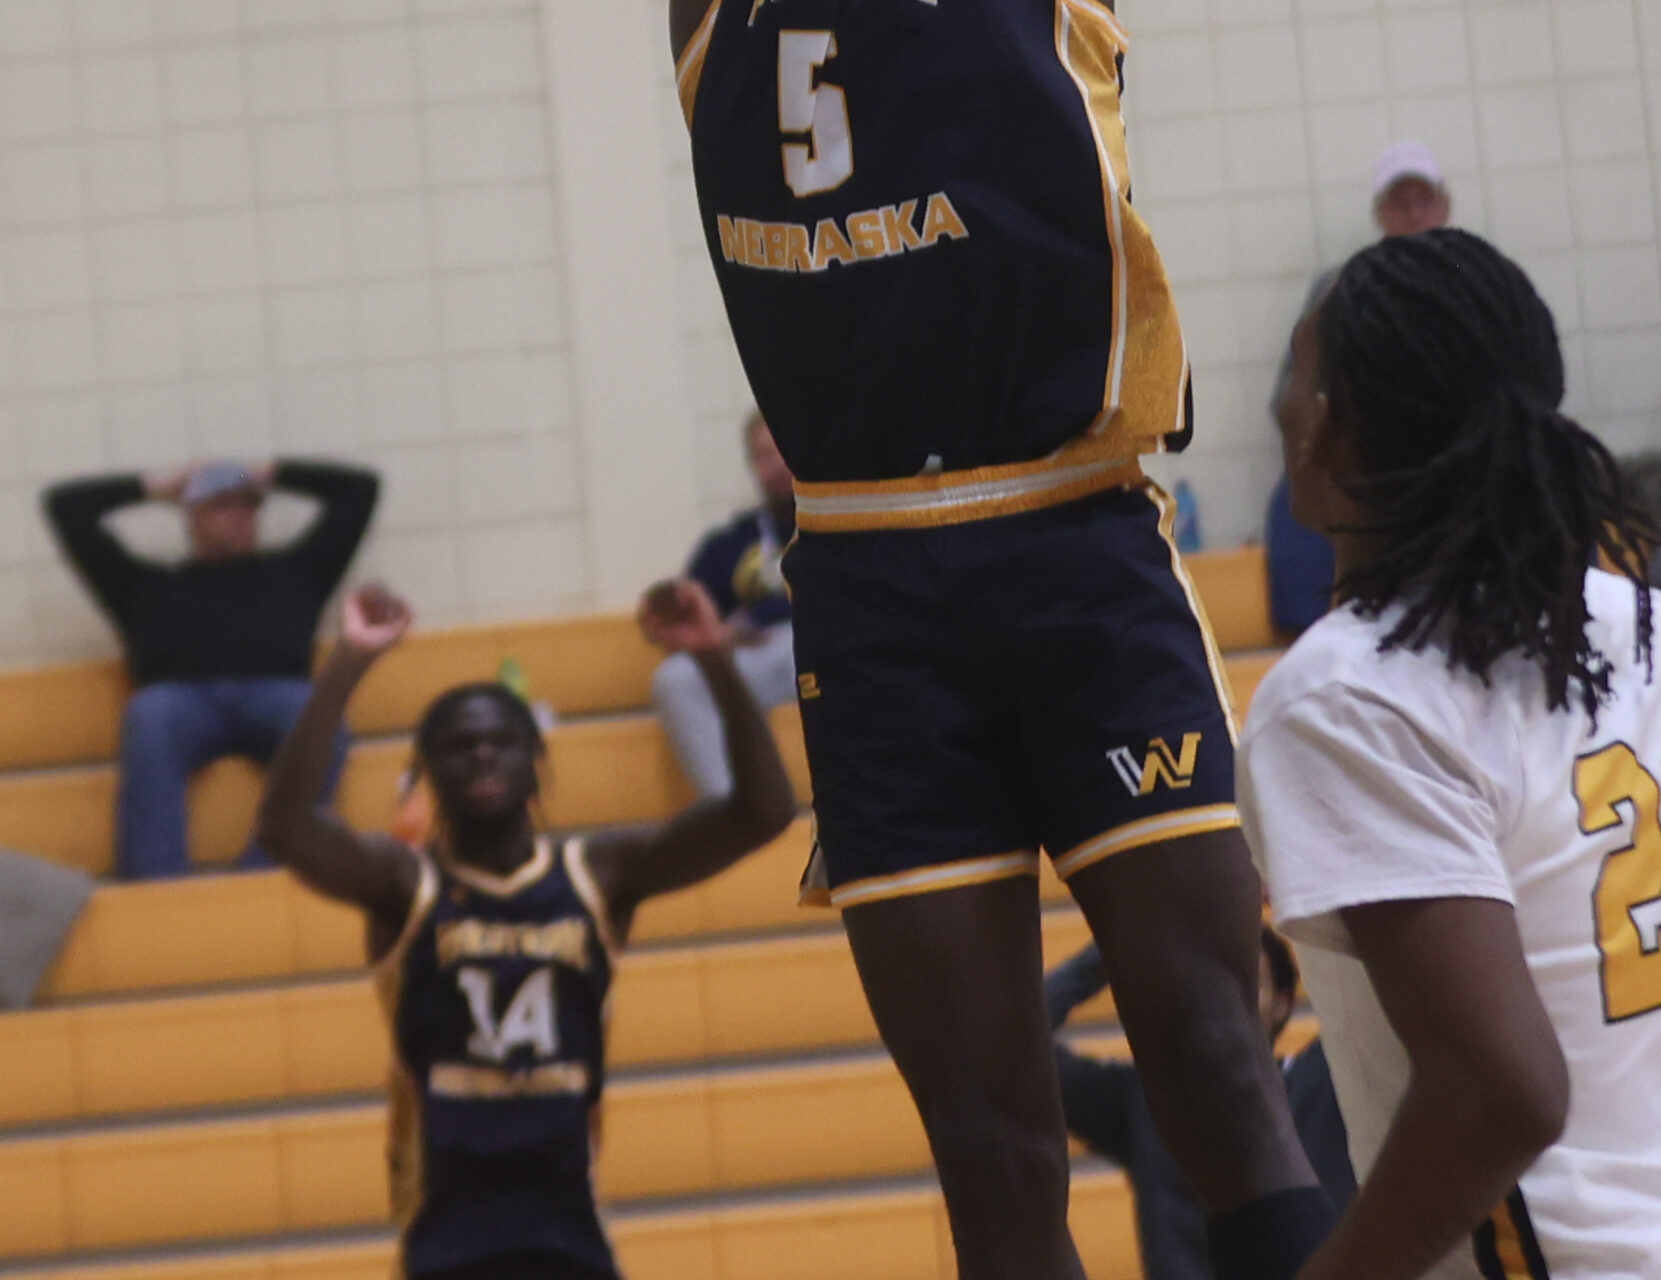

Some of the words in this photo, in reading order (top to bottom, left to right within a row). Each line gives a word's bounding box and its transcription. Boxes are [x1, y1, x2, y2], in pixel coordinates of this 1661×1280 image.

[777, 29, 854, 198] 5
[717, 191, 969, 273] NEBRASKA
[1573, 740, 1661, 1025] 2
[456, 966, 559, 1061] 14
